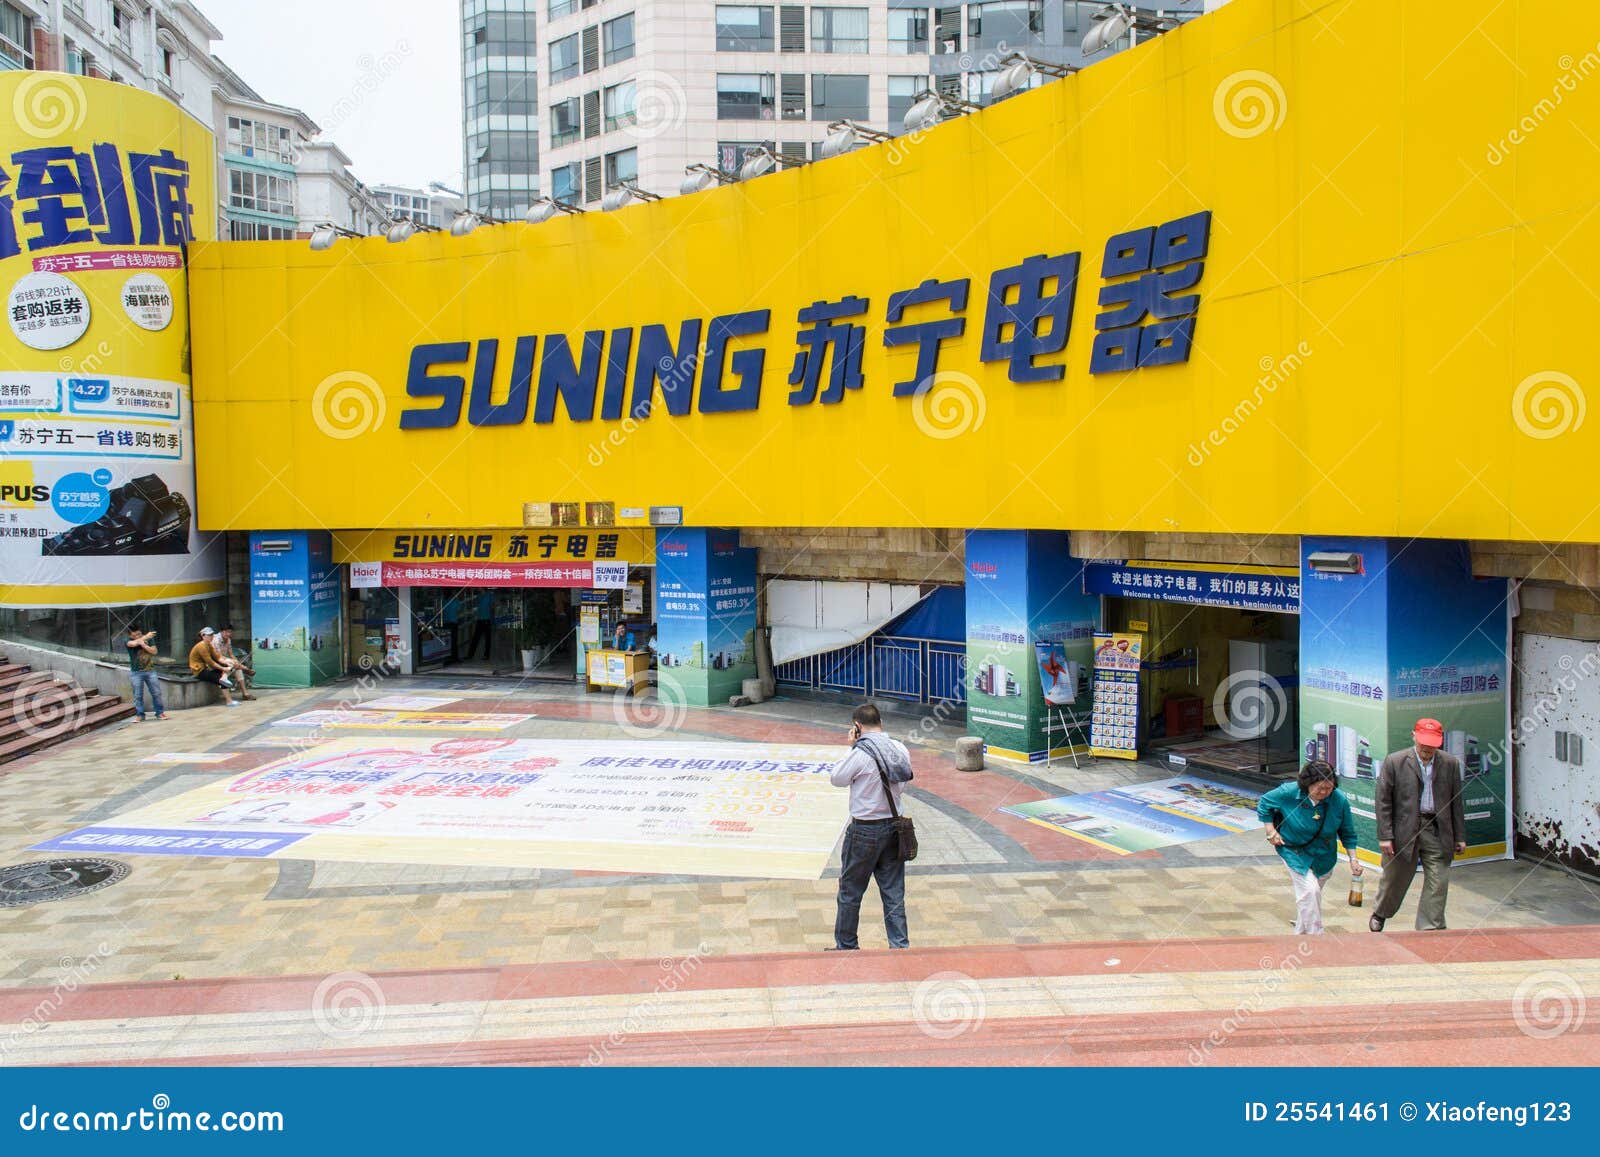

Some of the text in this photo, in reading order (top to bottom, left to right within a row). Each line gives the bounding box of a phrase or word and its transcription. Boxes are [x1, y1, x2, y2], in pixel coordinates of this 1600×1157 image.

[0, 141, 196, 258] 到底
[38, 253, 178, 272] 苏宁五一省钱购物季
[12, 298, 82, 321] 套购返券
[399, 210, 1213, 430] SUNING 苏宁电器
[75, 385, 105, 396] 4.27
[19, 427, 178, 449] 苏宁五一省钱购物季
[0, 485, 50, 502] PUS
[393, 534, 619, 558] SUNING 苏宁电器
[353, 567, 378, 577] Haier
[595, 567, 625, 575] SUNING
[1123, 589, 1151, 599] Welcome
[1204, 597, 1230, 606] service
[1286, 602, 1300, 612] fro
[60, 833, 170, 847] SUNING
